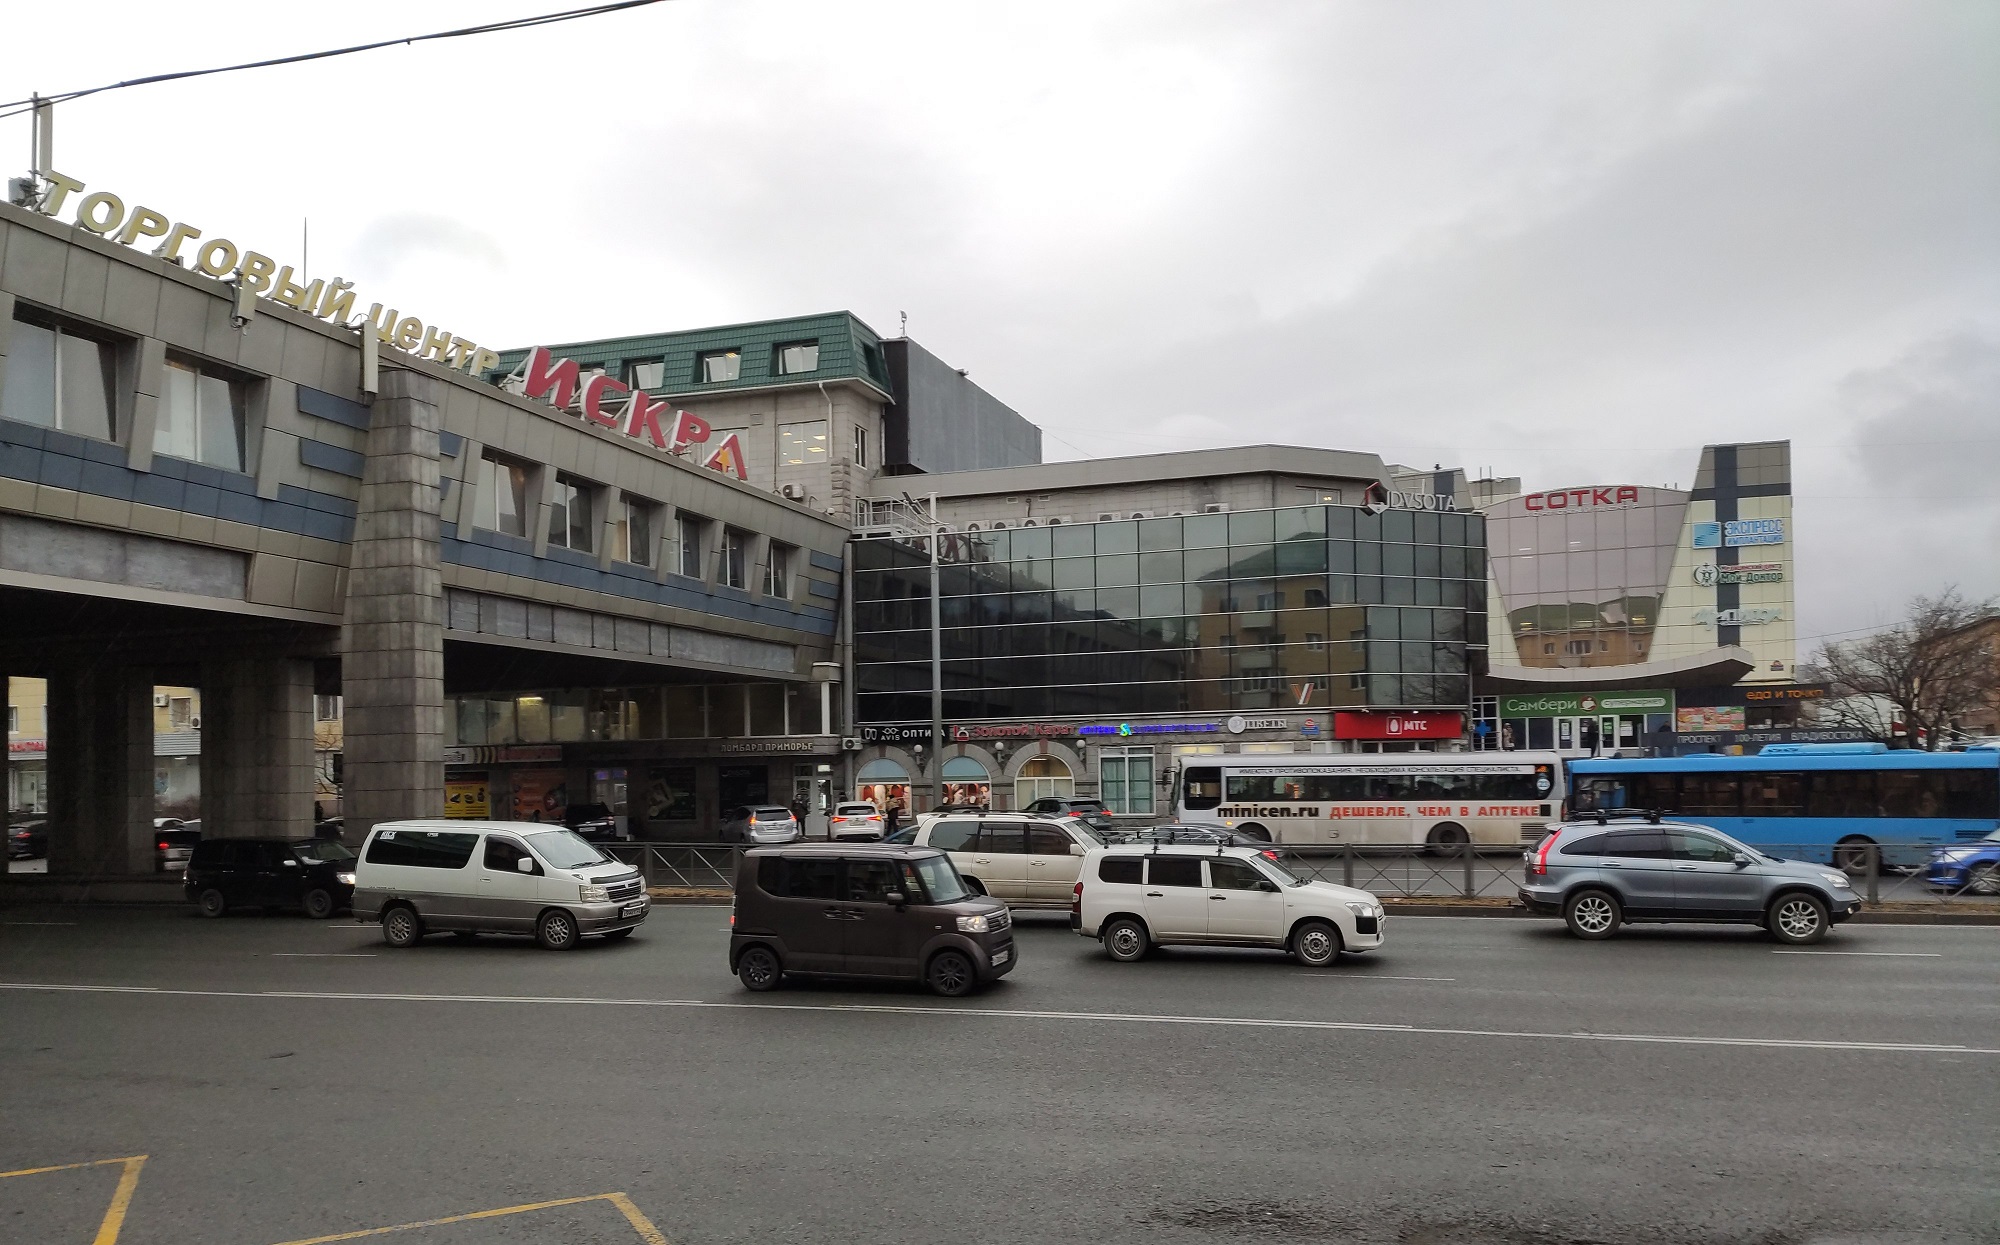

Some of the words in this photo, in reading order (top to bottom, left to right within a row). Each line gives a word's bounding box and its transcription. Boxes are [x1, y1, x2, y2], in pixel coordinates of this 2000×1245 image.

[42, 170, 357, 322] ТОРГОВЫЙ
[522, 346, 748, 481] ИСКРА
[1525, 486, 1638, 511] СОТКА
[1725, 519, 1783, 534] ЭКСПРЕСС
[1746, 691, 1772, 701] еда
[1506, 698, 1577, 713] Самбери
[1404, 720, 1428, 731] МТС
[902, 729, 945, 738] ОПТИА
[1678, 734, 1722, 744] ПРОСПЕКТ
[1734, 733, 1782, 743] 100-ЛЕТИЯ
[1790, 731, 1864, 742] ВЛАДИВОСТОКА
[721, 744, 763, 752] ЛОМБАРД
[765, 742, 813, 751] ПРИМОРЬЕ
[1217, 803, 1319, 817] minicen.ru
[1330, 806, 1410, 818] ДЕШЕВЛЕ,
[1417, 806, 1451, 816] ЧЕМ
[1460, 806, 1469, 816] В
[1477, 806, 1540, 816] АПТЕКЕ
